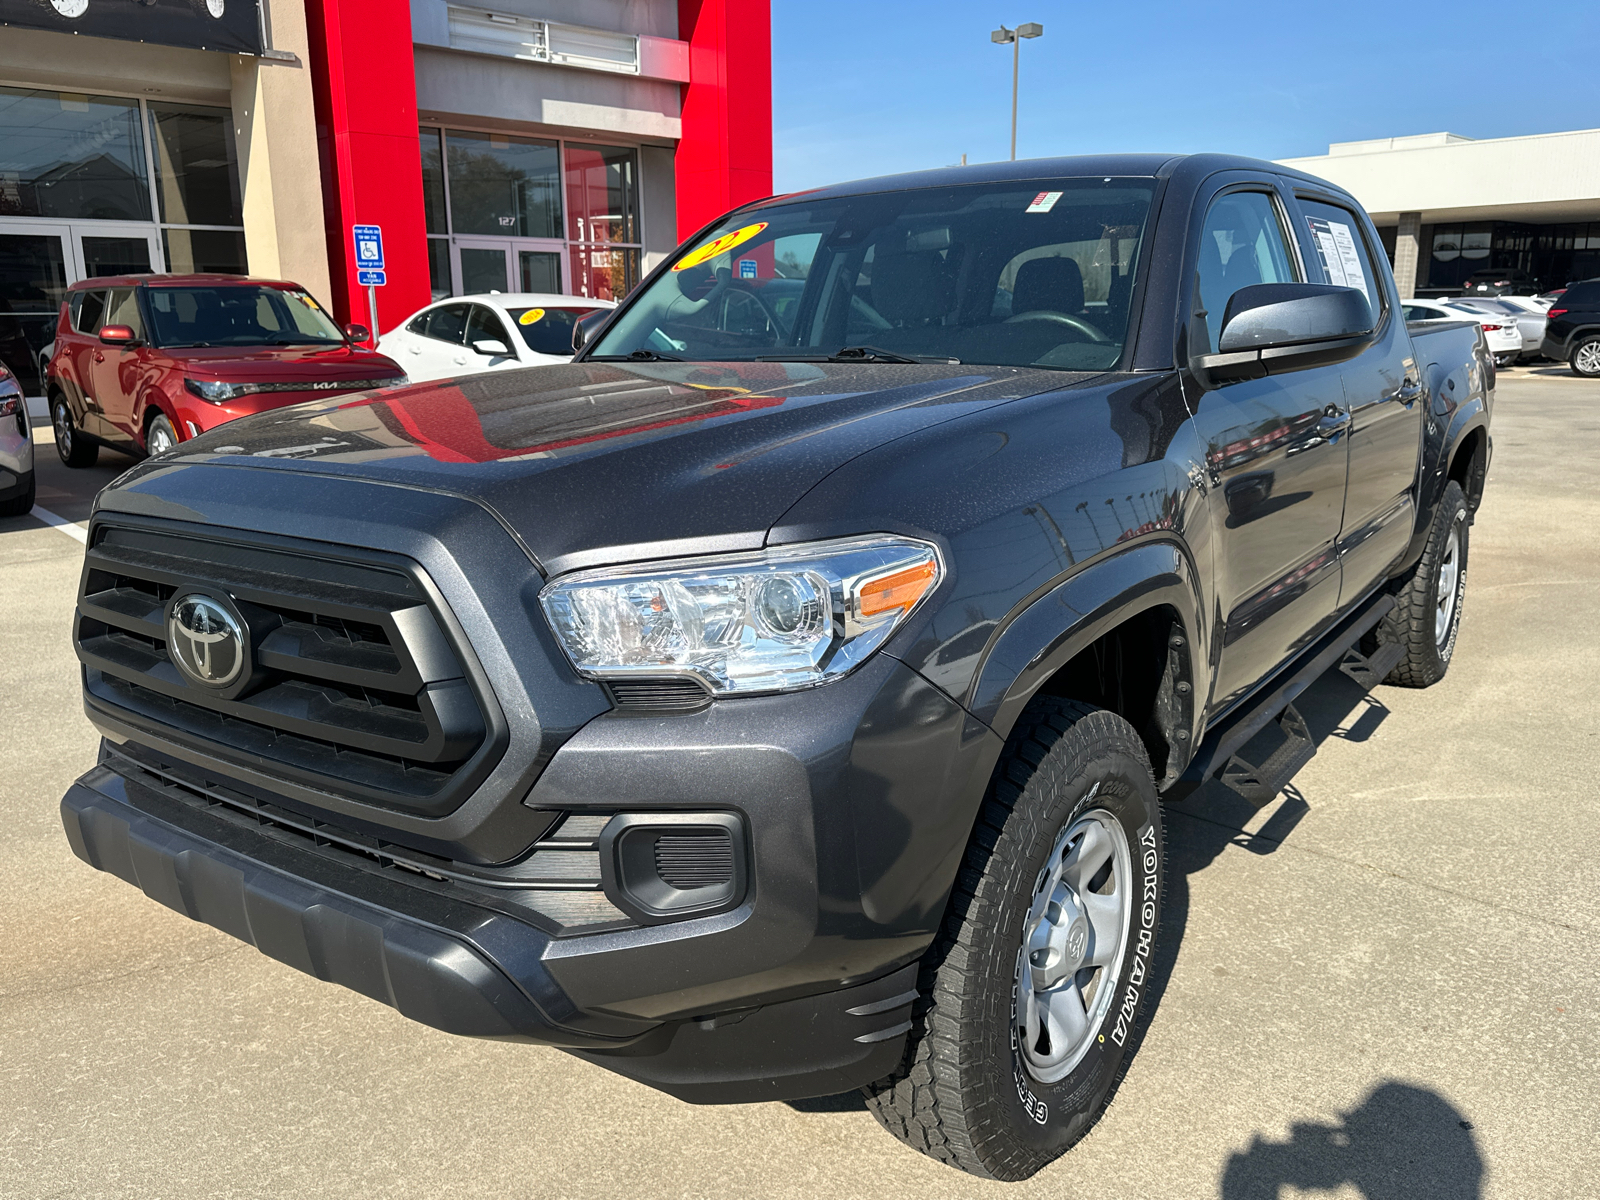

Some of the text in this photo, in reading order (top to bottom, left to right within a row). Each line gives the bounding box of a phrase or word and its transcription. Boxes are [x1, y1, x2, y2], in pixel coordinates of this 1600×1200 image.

[498, 216, 516, 226] 127
[697, 231, 740, 263] 22
[1111, 825, 1158, 1047] YOKOHAMA
